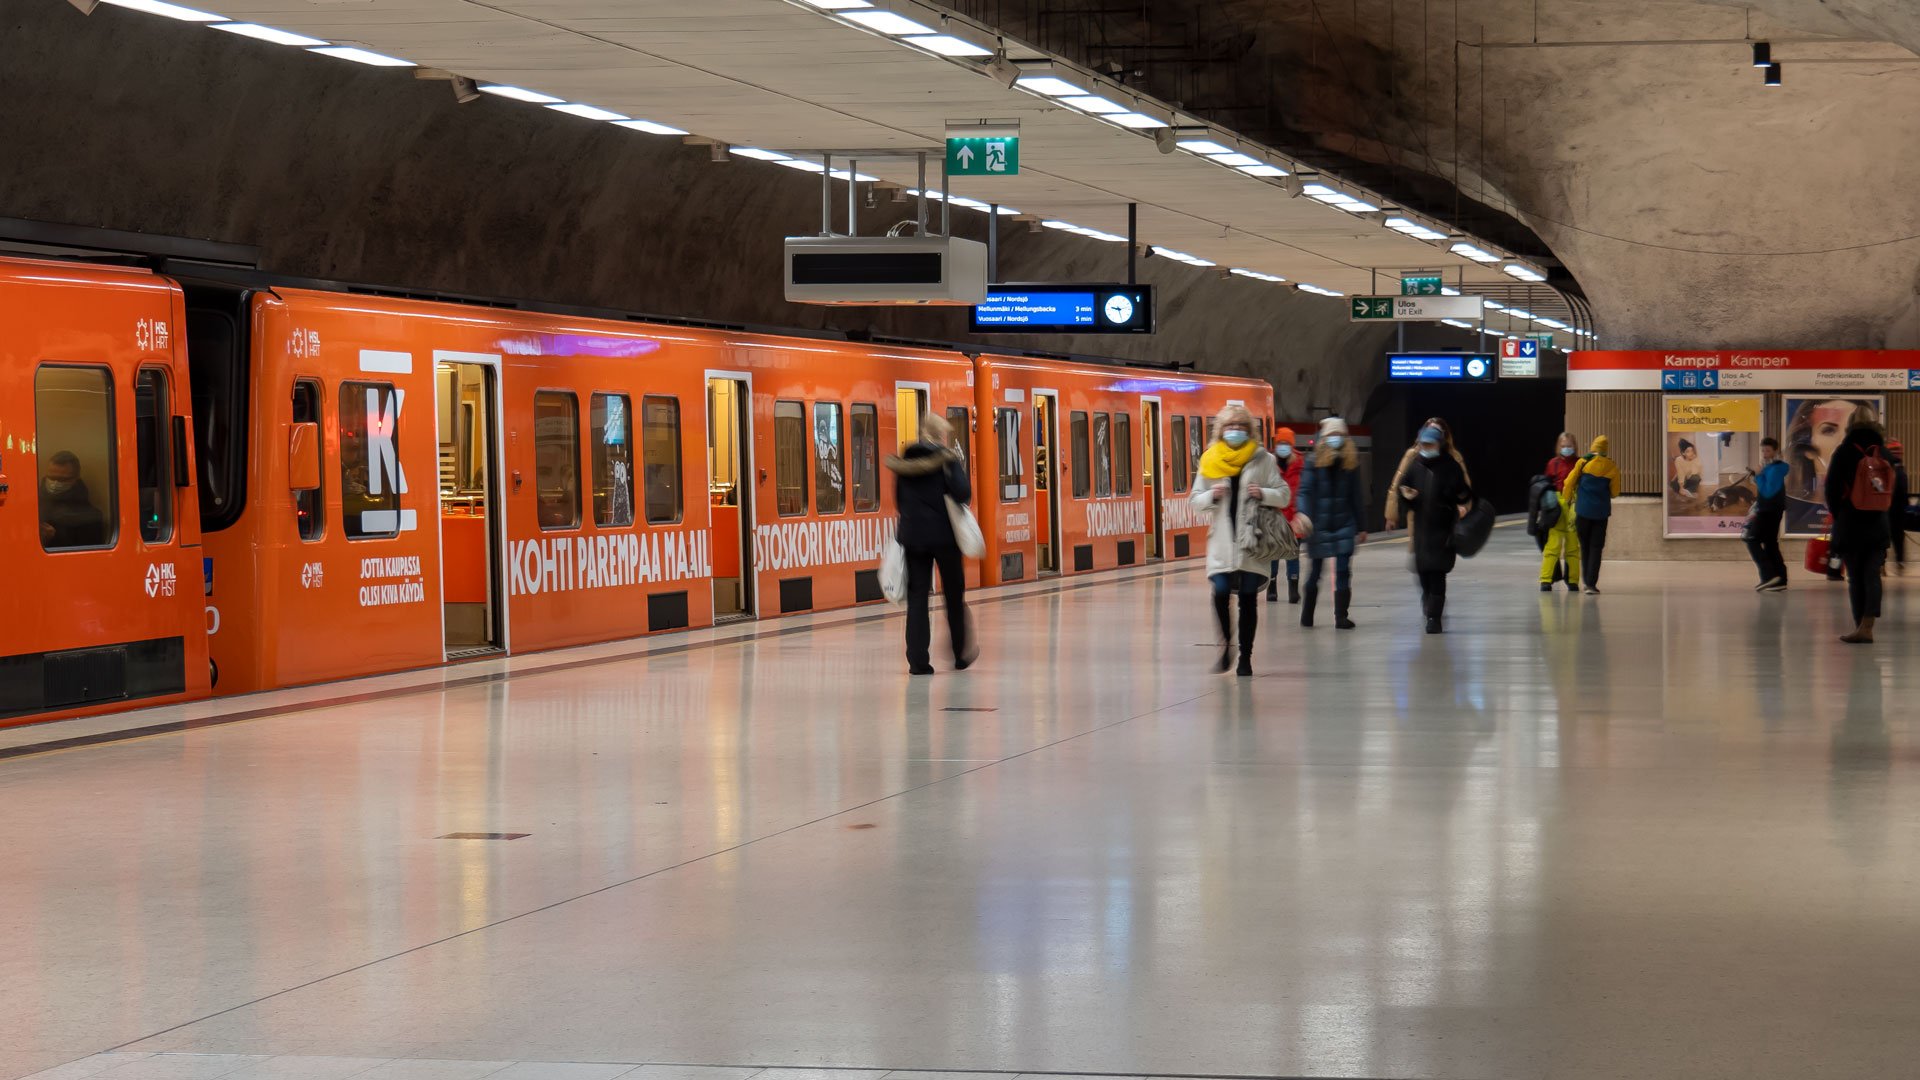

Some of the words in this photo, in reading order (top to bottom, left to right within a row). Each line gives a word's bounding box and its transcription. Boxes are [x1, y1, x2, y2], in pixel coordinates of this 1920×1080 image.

[155, 321, 168, 335] HSL
[156, 335, 168, 348] HRT
[309, 331, 320, 343] HSL
[1664, 355, 1720, 368] Kamppi
[1730, 355, 1790, 368] Kampen
[1672, 404, 1680, 414] Ei
[1683, 404, 1712, 414] koiraa
[1672, 416, 1728, 424] haudattuna
[366, 388, 408, 494] K
[1006, 411, 1024, 476] K
[312, 562, 323, 574] HKL
[360, 558, 384, 579] JOTTA
[386, 556, 420, 577] KAUPASSA
[510, 538, 574, 596] KOHTI
[578, 533, 662, 589] PAREMPAA
[664, 529, 712, 581] MAAIL
[160, 563, 176, 579] HKL
[162, 580, 176, 596] HST
[312, 574, 323, 588] HST
[360, 586, 380, 606] OLISI
[381, 584, 398, 605] KIVA
[400, 577, 424, 603] KÄYDÄ
